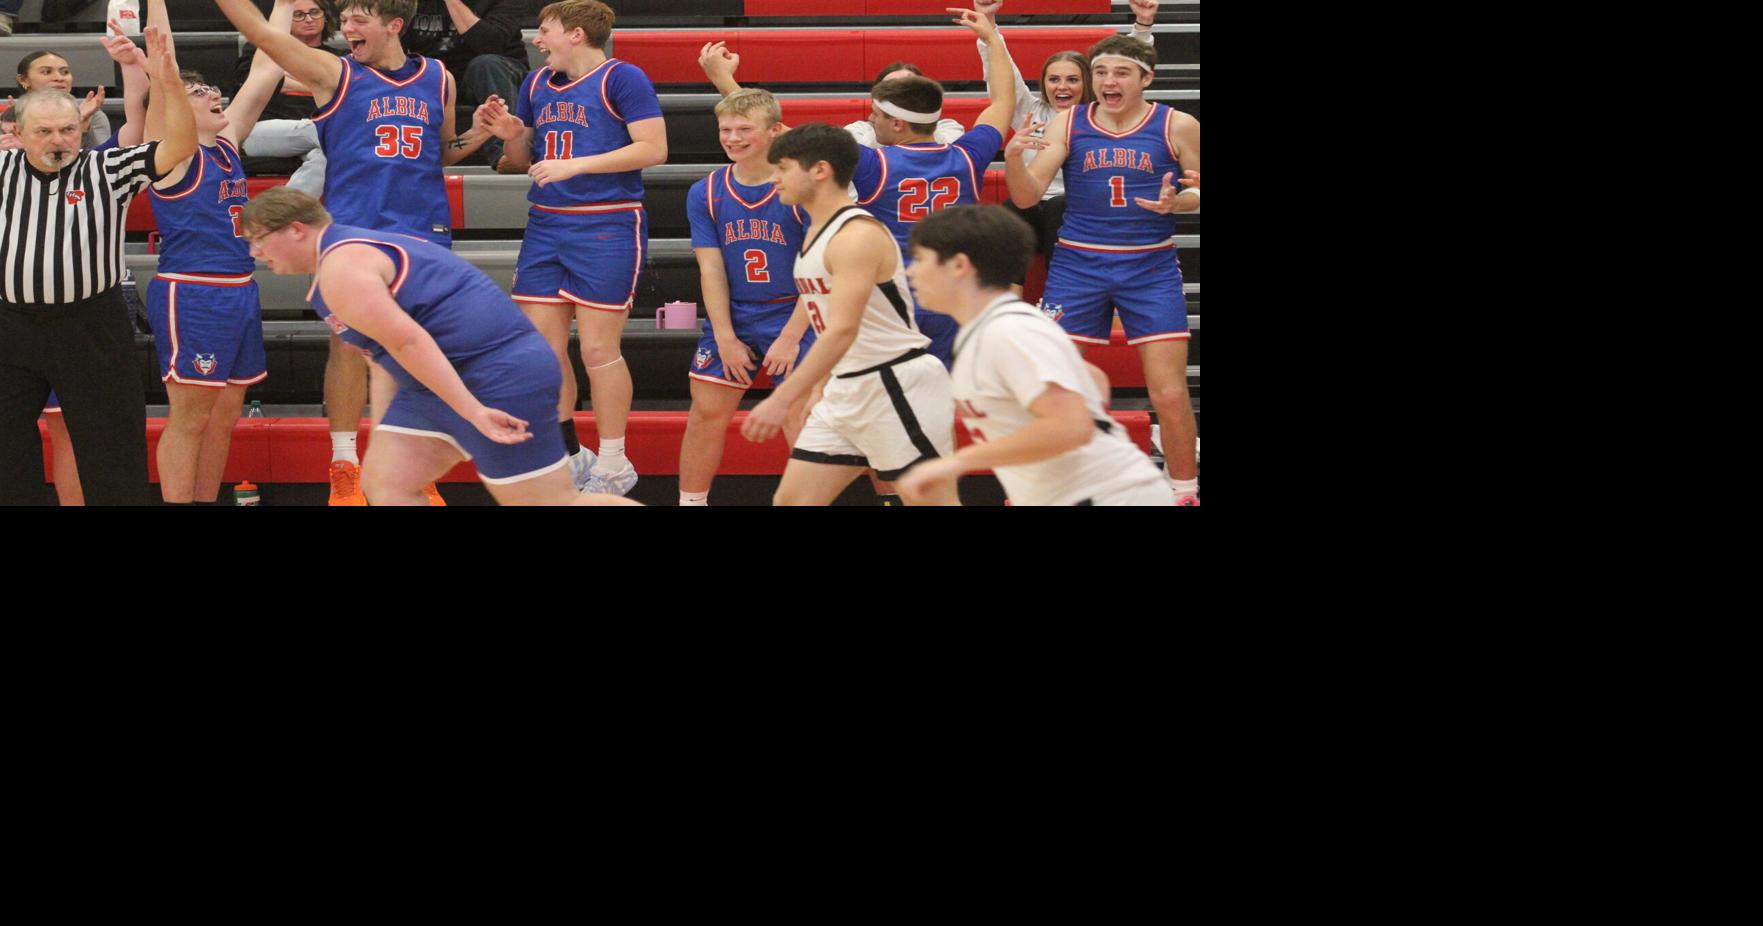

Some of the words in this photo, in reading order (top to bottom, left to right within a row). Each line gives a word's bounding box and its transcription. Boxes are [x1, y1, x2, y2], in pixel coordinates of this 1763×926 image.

[366, 95, 430, 126] ALBIA
[536, 101, 590, 129] ALBIA
[374, 124, 424, 160] 35
[543, 130, 573, 161] 11
[1082, 147, 1154, 174] ALBIA
[897, 176, 961, 223] 22
[1108, 175, 1128, 208] 1
[724, 218, 787, 246] ALBIA
[743, 248, 771, 283] 2
